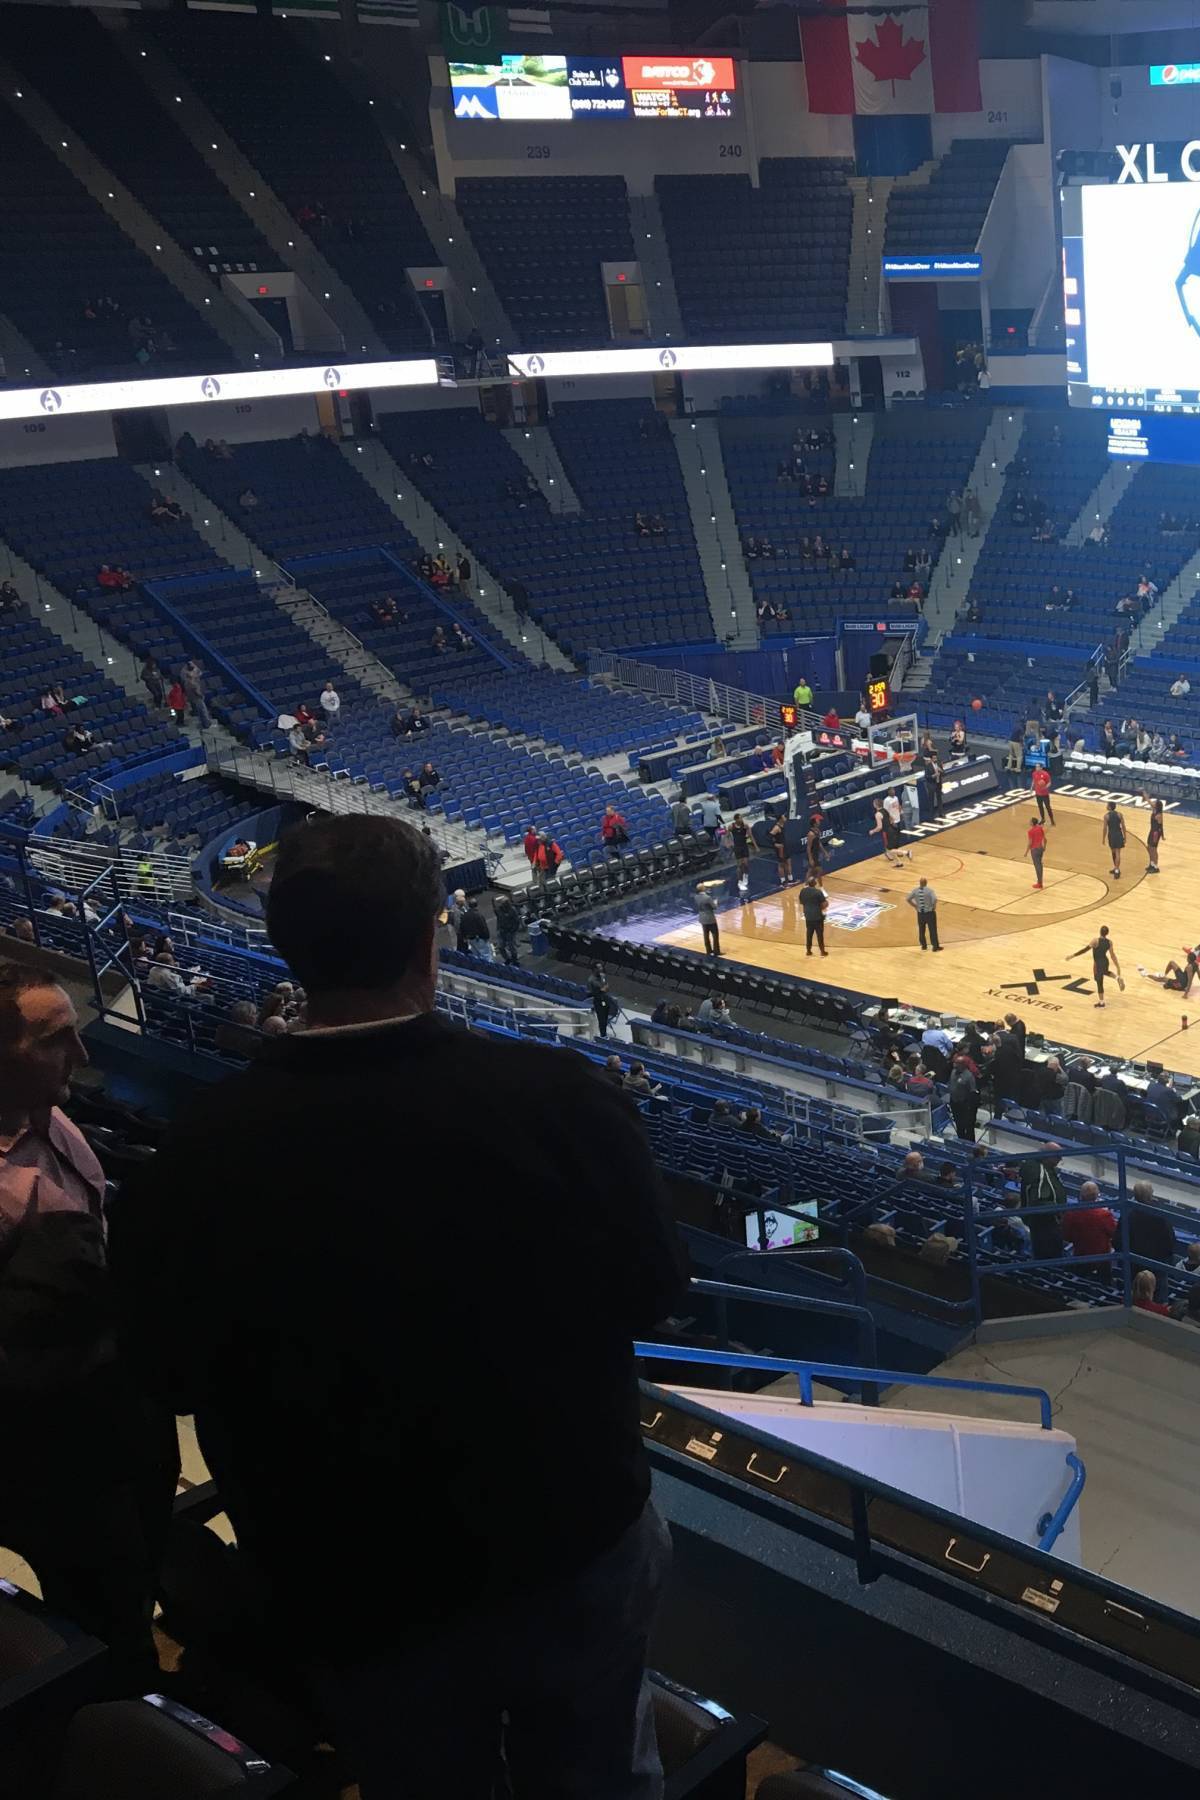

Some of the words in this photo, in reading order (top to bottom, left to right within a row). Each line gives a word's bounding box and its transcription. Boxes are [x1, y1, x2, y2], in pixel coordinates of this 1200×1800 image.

[527, 146, 551, 159] 239
[719, 145, 742, 157] 240
[1116, 143, 1169, 184] XL
[895, 370, 911, 379] 112
[23, 422, 46, 434] 109
[870, 692, 885, 709] 30
[1054, 784, 1181, 812] UCONN
[901, 787, 1036, 838] HUSKIES
[983, 988, 1002, 998] XL
[1004, 995, 1064, 1013] CENTER
